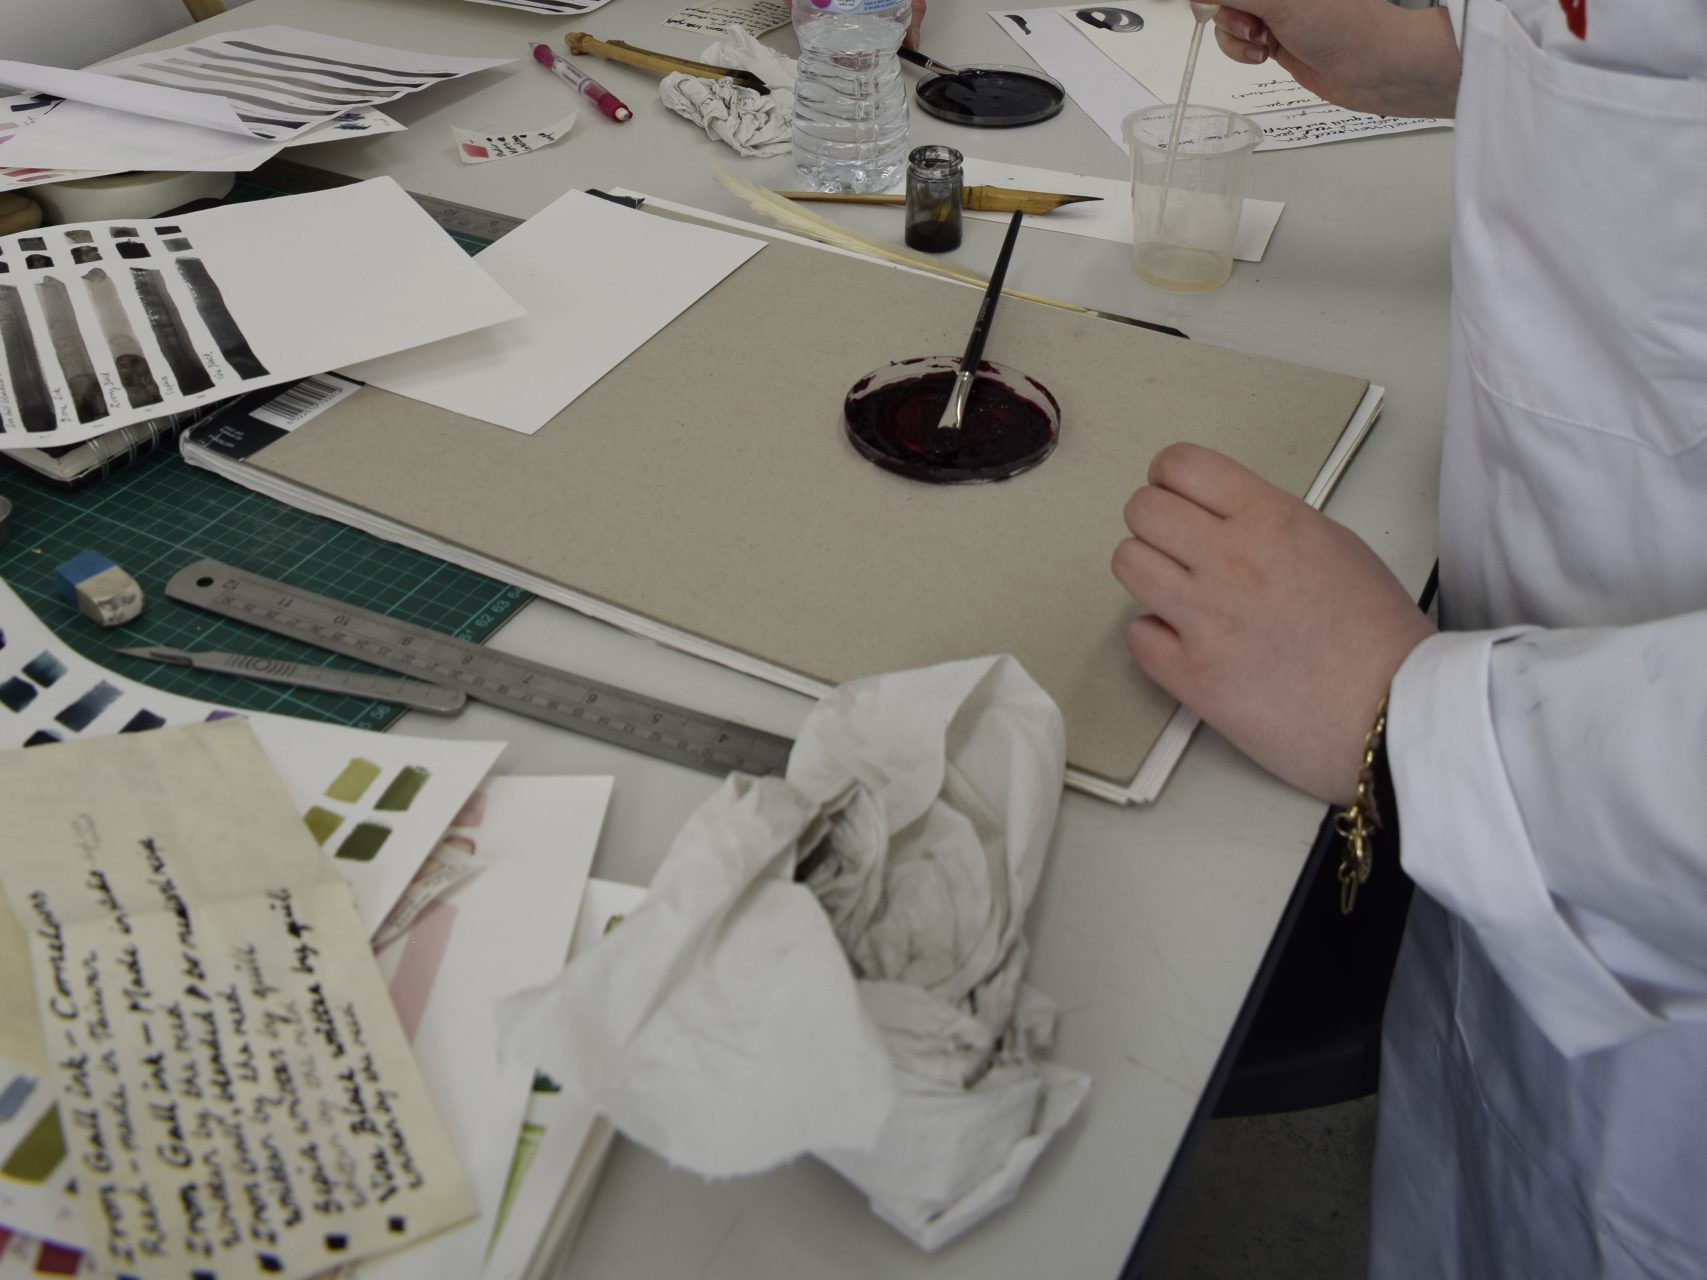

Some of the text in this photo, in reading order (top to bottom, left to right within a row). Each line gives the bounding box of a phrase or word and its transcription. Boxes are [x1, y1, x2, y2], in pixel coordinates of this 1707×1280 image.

[222, 578, 238, 591] 12
[277, 596, 292, 608] 11
[333, 614, 350, 627] 10
[475, 613, 495, 628] 62
[491, 600, 510, 614] 63
[401, 635, 414, 647] 9
[461, 654, 474, 666] 8
[521, 673, 535, 685] 7
[585, 692, 598, 705] 6
[649, 712, 664, 725] 5
[716, 733, 730, 745] 4
[120, 948, 151, 1012] Made
[233, 943, 280, 1000] quill
[293, 943, 318, 974] by
[218, 986, 246, 1036] reed
[308, 983, 345, 1058] written
[61, 1055, 92, 1099] ink
[143, 1052, 169, 1092] ink
[269, 1050, 309, 1134] written
[109, 1085, 136, 1152] made
[251, 1089, 284, 1125] by
[338, 1063, 382, 1136] Black
[75, 1110, 112, 1174] Gall
[150, 1103, 193, 1169] Gall
[166, 1003, 241, 1248] written by the reed
[262, 1138, 303, 1228] written
[300, 1143, 344, 1216] Sepia
[371, 1148, 398, 1204] Vine
